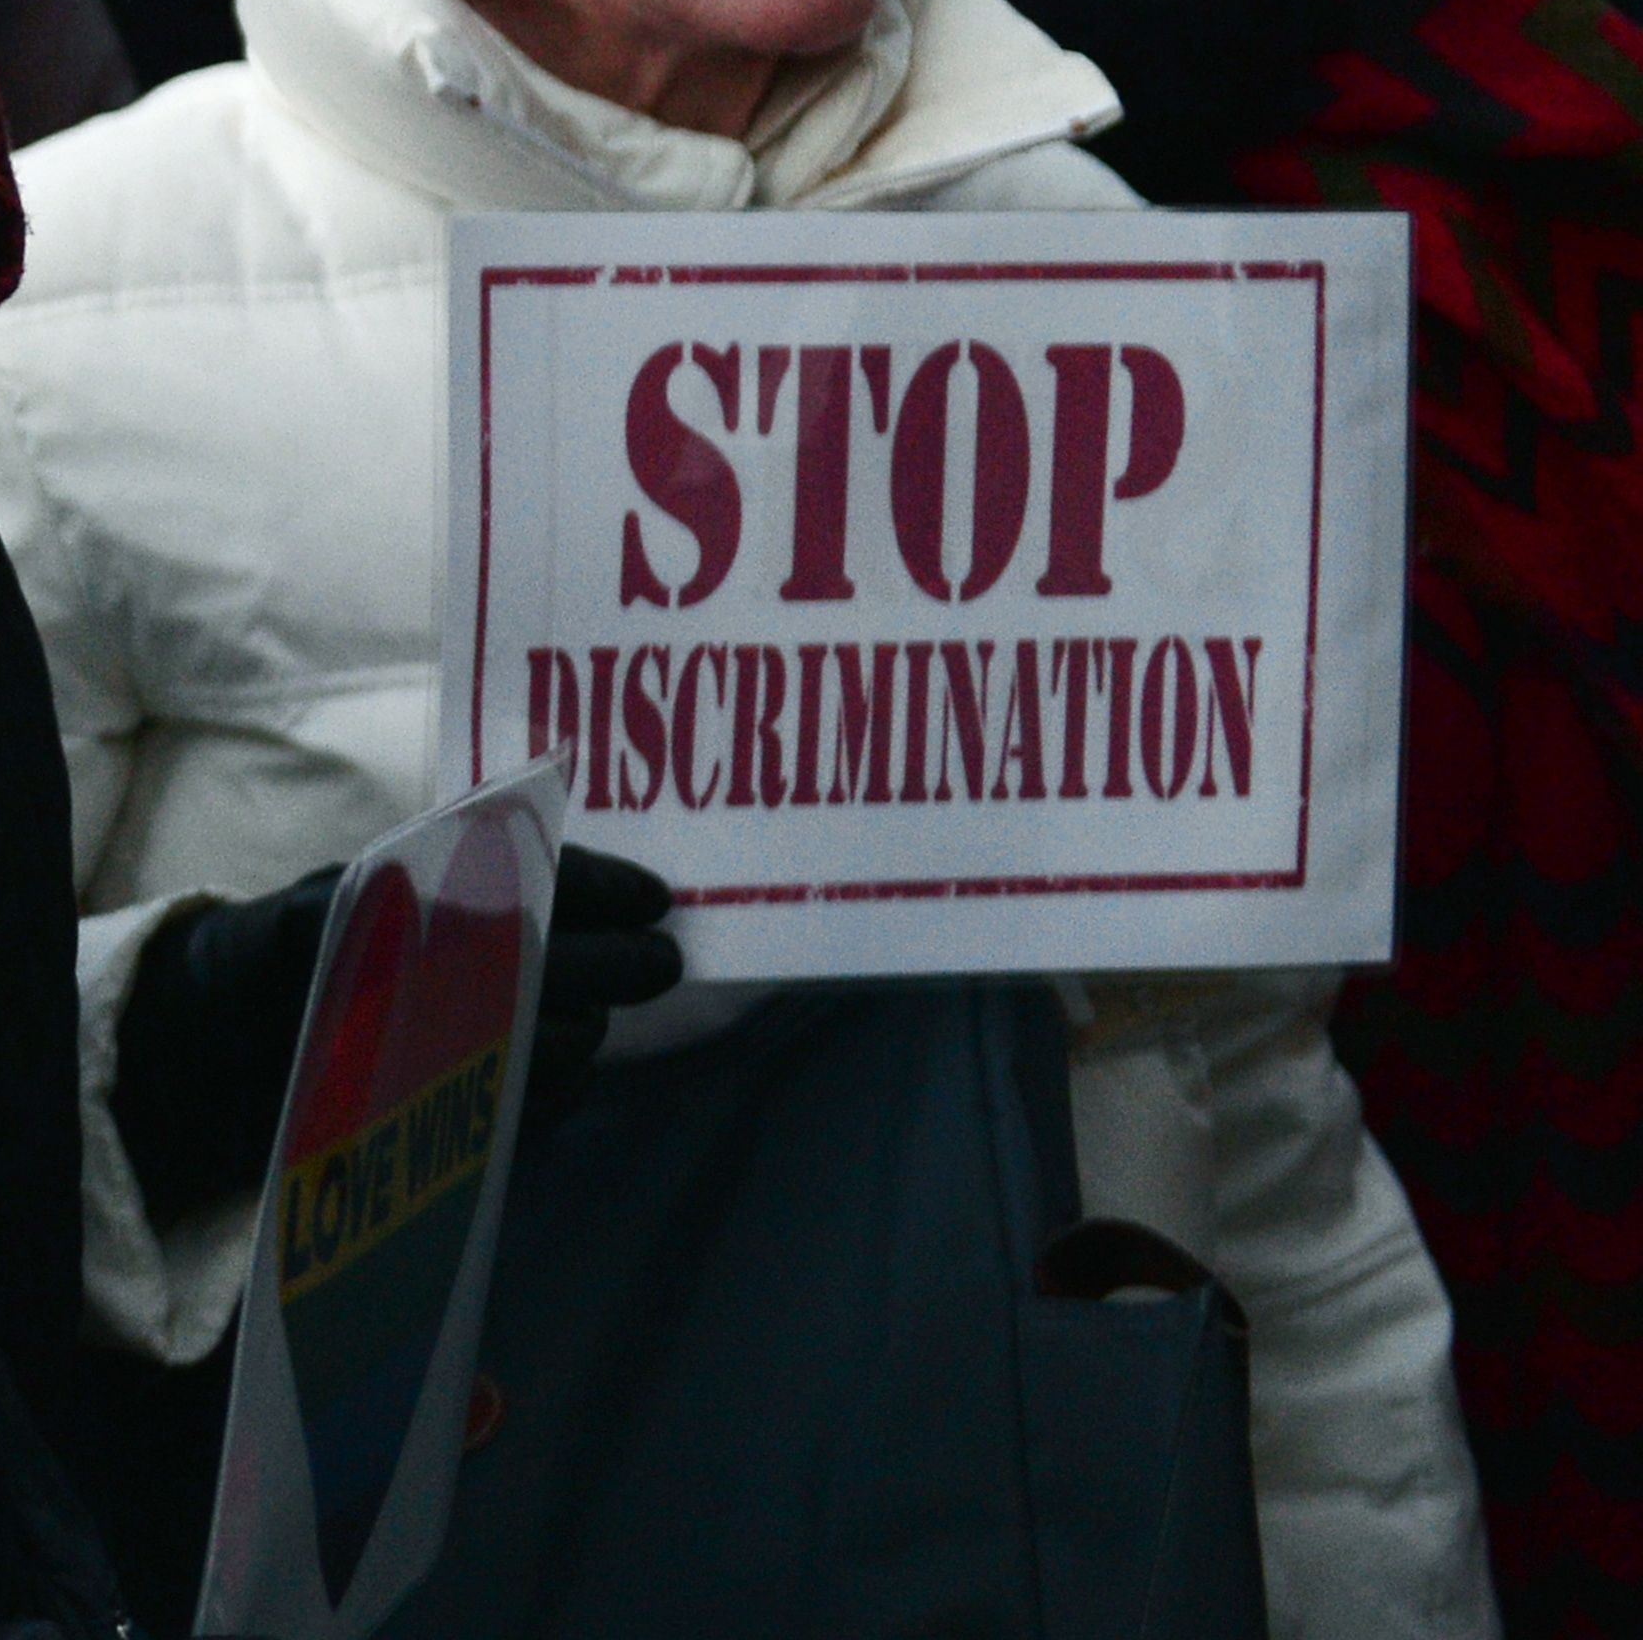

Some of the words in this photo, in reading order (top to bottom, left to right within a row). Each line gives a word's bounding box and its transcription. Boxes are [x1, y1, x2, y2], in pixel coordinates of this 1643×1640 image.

[619, 339, 1186, 609] STOP
[526, 635, 1263, 813] DISCRIMINATION
[281, 1115, 400, 1283] LOVE
[405, 1050, 499, 1198] WINS
